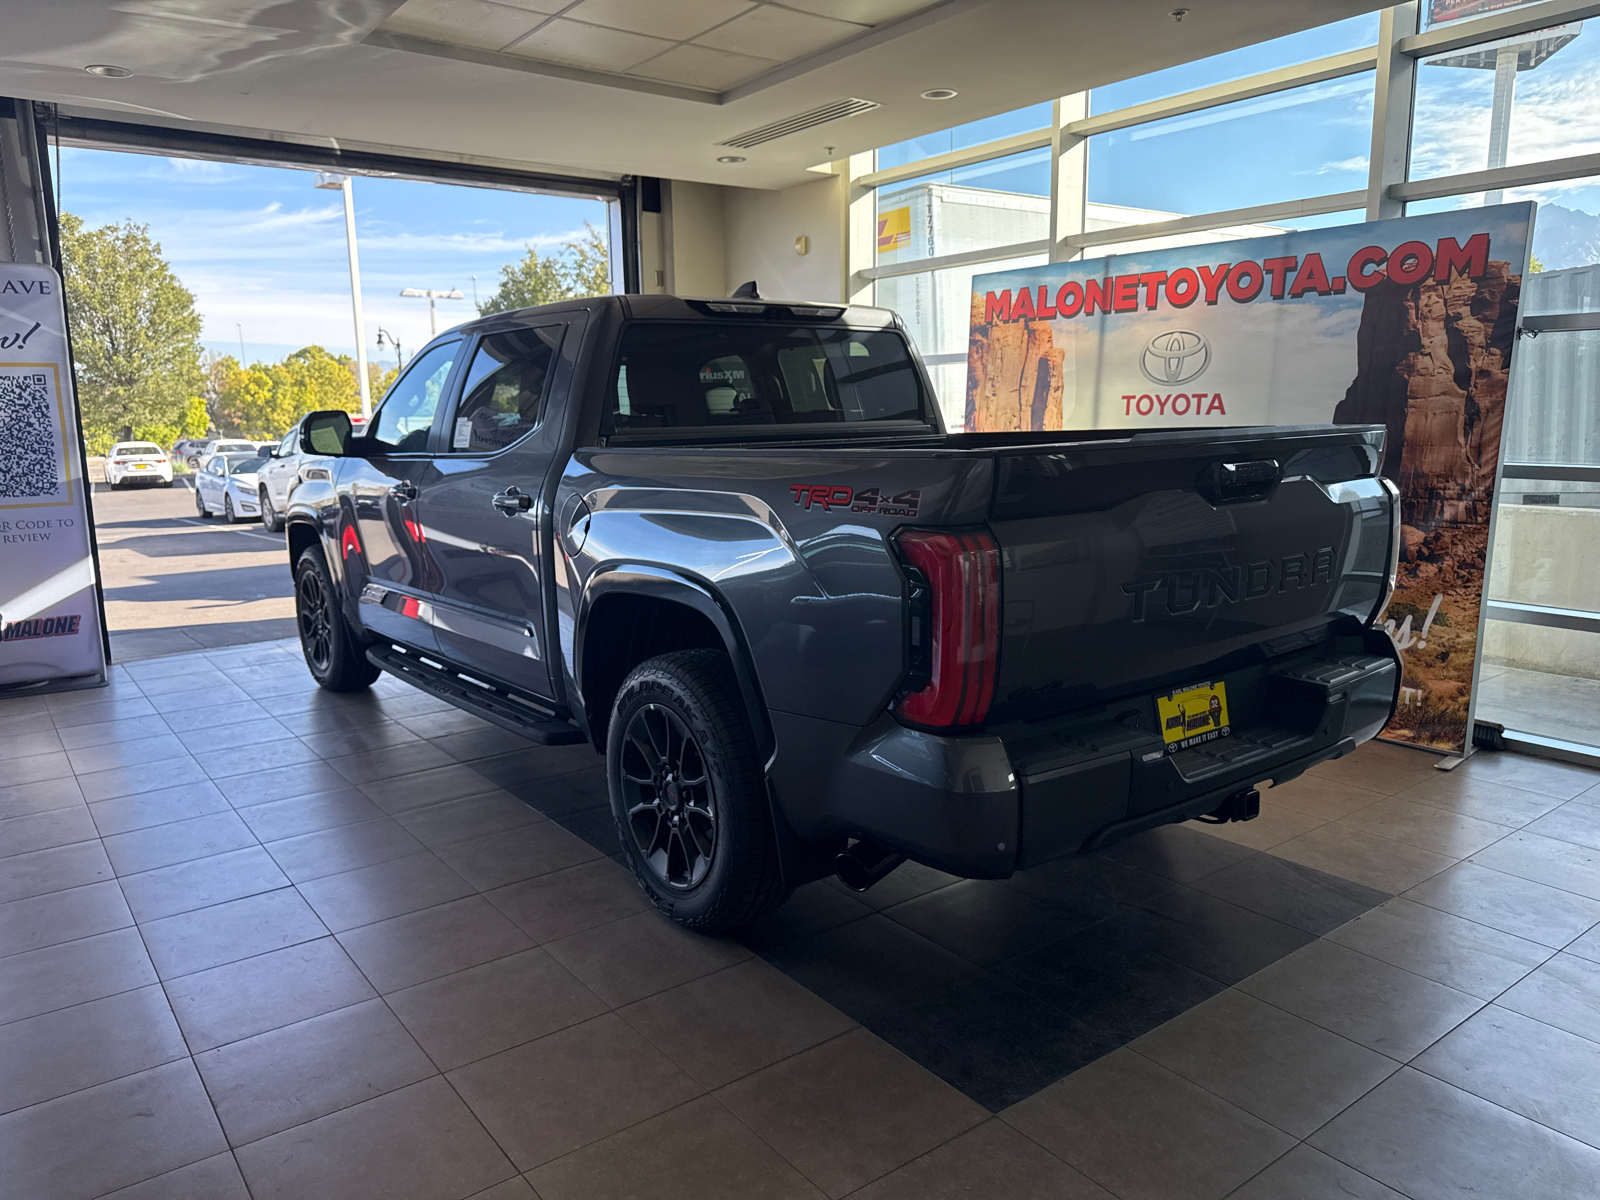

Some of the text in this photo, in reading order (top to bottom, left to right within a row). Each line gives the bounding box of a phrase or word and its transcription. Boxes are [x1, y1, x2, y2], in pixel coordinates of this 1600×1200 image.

[984, 232, 1491, 324] MALONETOYOTA.COM
[1121, 393, 1226, 416] TOYOTA
[789, 484, 922, 514] TRD 4x4
[56, 518, 74, 528] TO
[851, 505, 918, 518] OFF ROAD
[3, 532, 51, 544] REVIEW
[1119, 546, 1338, 623] TUNDRA
[2, 614, 81, 641] MALONE
[617, 680, 698, 725] WILDPEAK
[1210, 699, 1219, 709] 32
[1180, 730, 1219, 749] WE MAKE IT EASY
